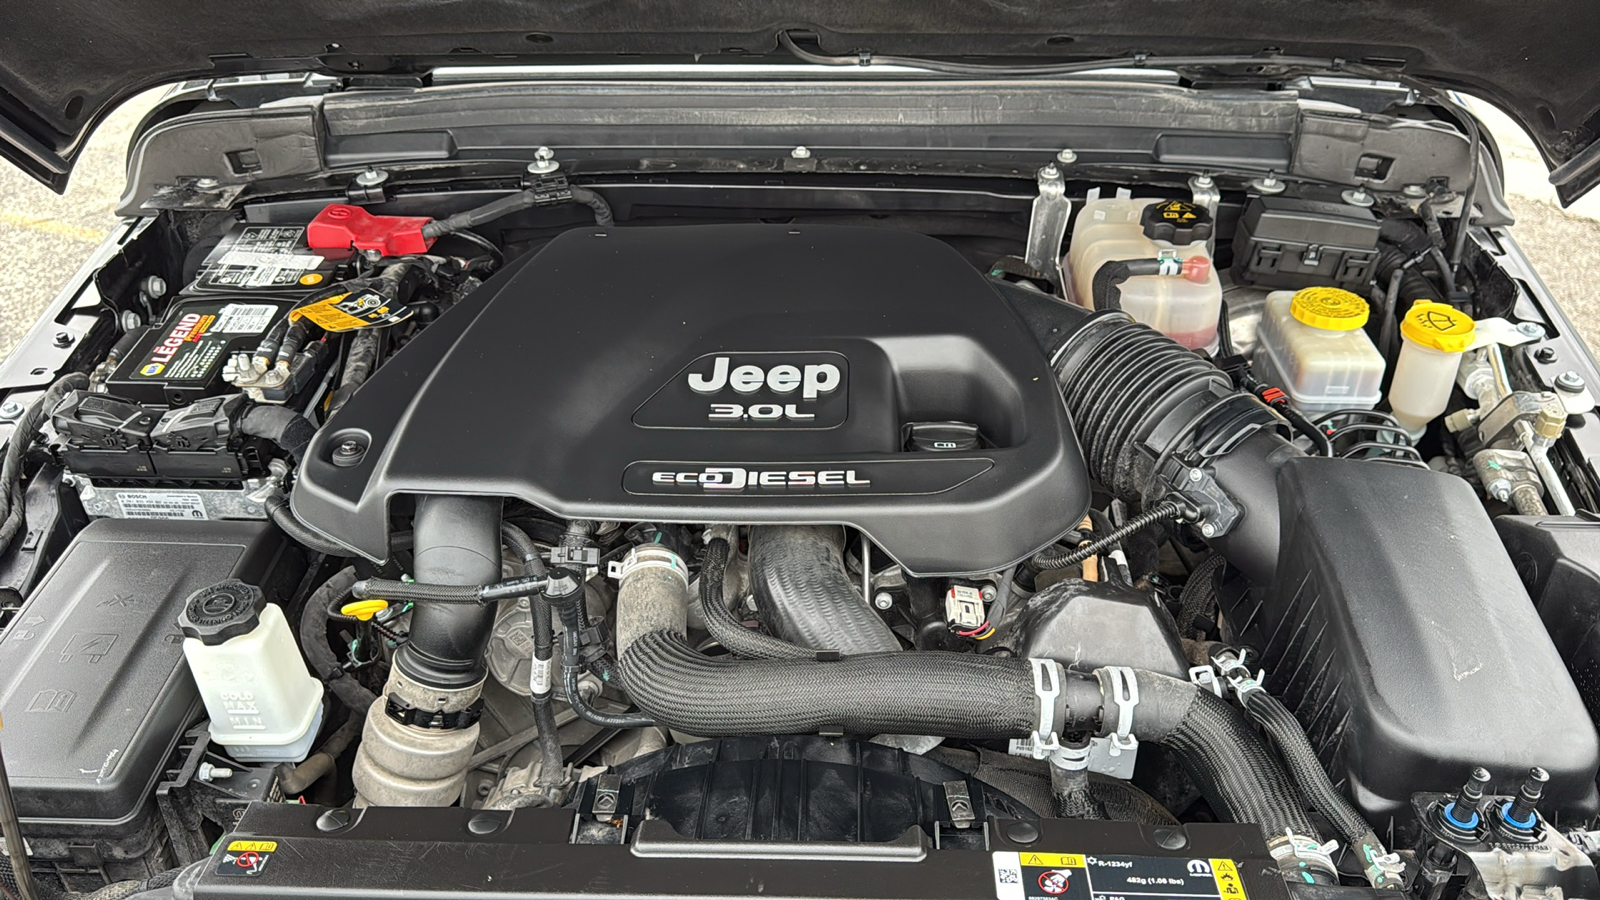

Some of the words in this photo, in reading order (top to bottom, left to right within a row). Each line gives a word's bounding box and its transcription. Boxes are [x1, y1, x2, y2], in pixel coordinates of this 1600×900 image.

[151, 313, 201, 364] LEGEND
[687, 356, 841, 400] Jeep
[708, 403, 816, 420] 3.0L
[221, 691, 254, 701] COLD
[223, 701, 257, 711] MAX
[229, 717, 262, 726] MIN
[1098, 860, 1133, 869] R-1234yf
[1126, 876, 1147, 885] 482g
